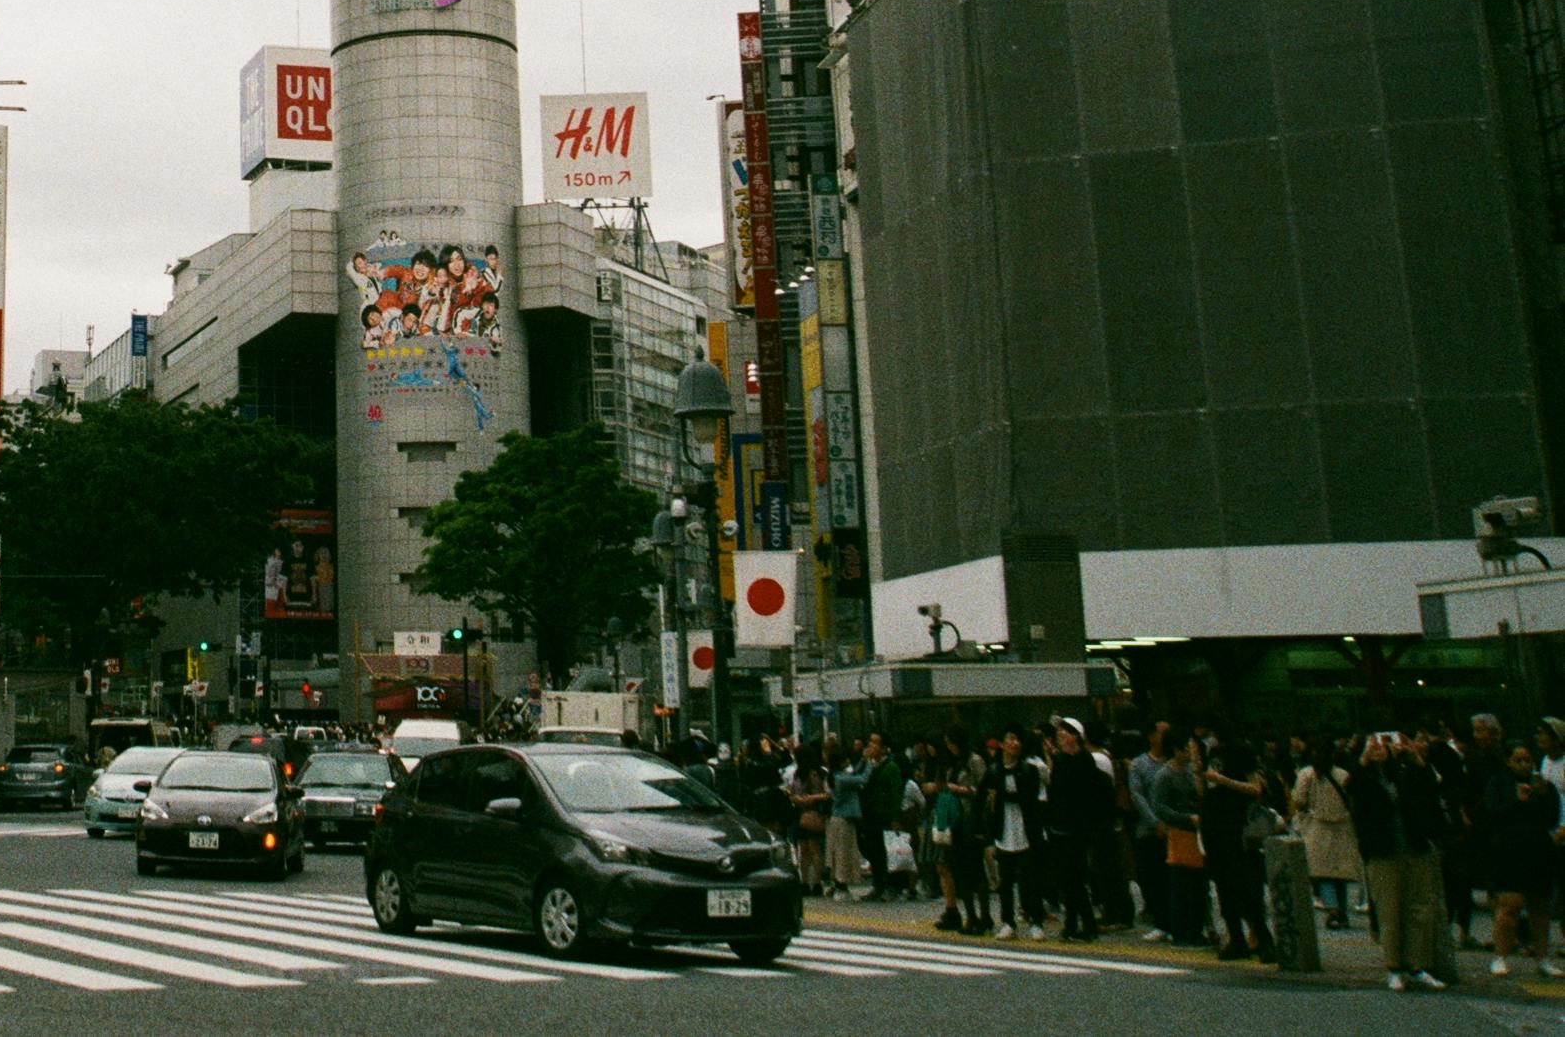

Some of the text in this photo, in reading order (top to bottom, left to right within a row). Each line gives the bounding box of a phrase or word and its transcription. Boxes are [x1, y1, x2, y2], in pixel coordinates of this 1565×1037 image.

[554, 104, 636, 161] H&M
[563, 172, 614, 187] 150m
[770, 495, 781, 549] MIZUHO
